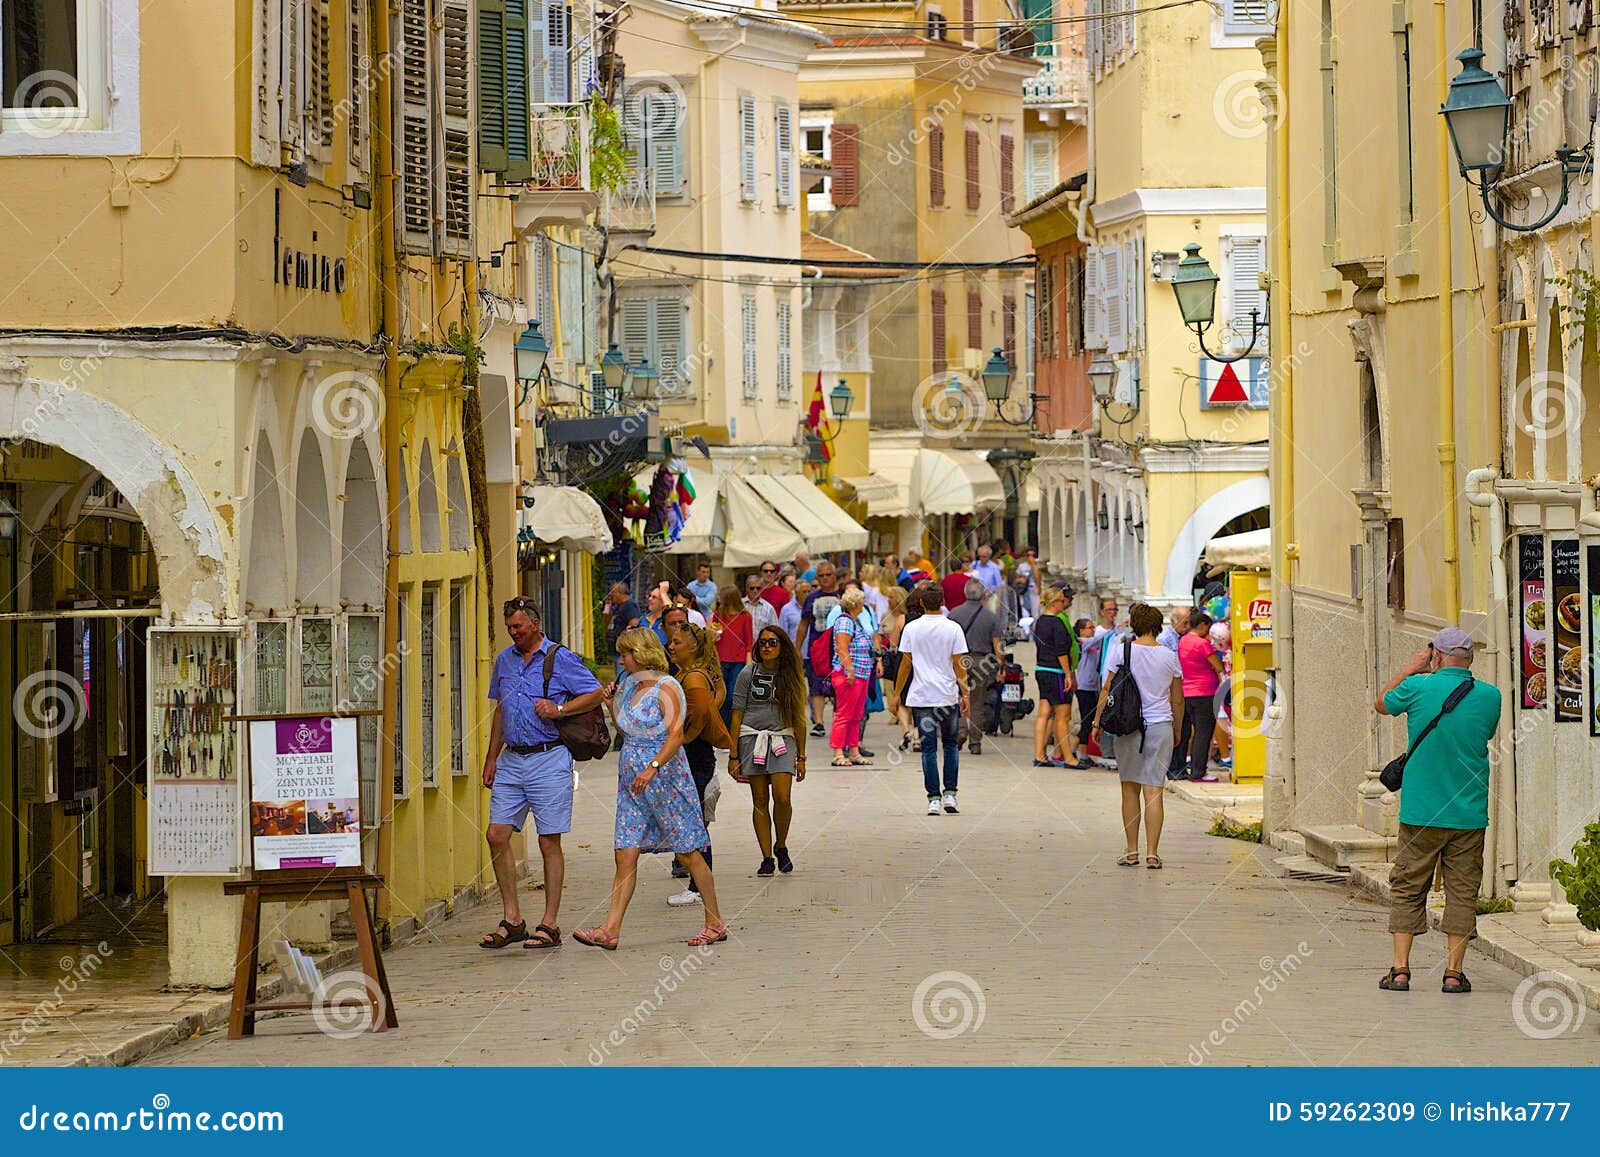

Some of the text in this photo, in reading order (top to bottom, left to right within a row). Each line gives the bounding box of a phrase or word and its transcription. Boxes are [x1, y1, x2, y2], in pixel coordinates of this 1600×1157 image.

[276, 766, 334, 777] ΕΚΘΕΣΗ
[276, 776, 335, 788] ΖΩΝΤΑΝΗΣ
[277, 788, 335, 799] ΙΣΤΟΡΙΑΣ
